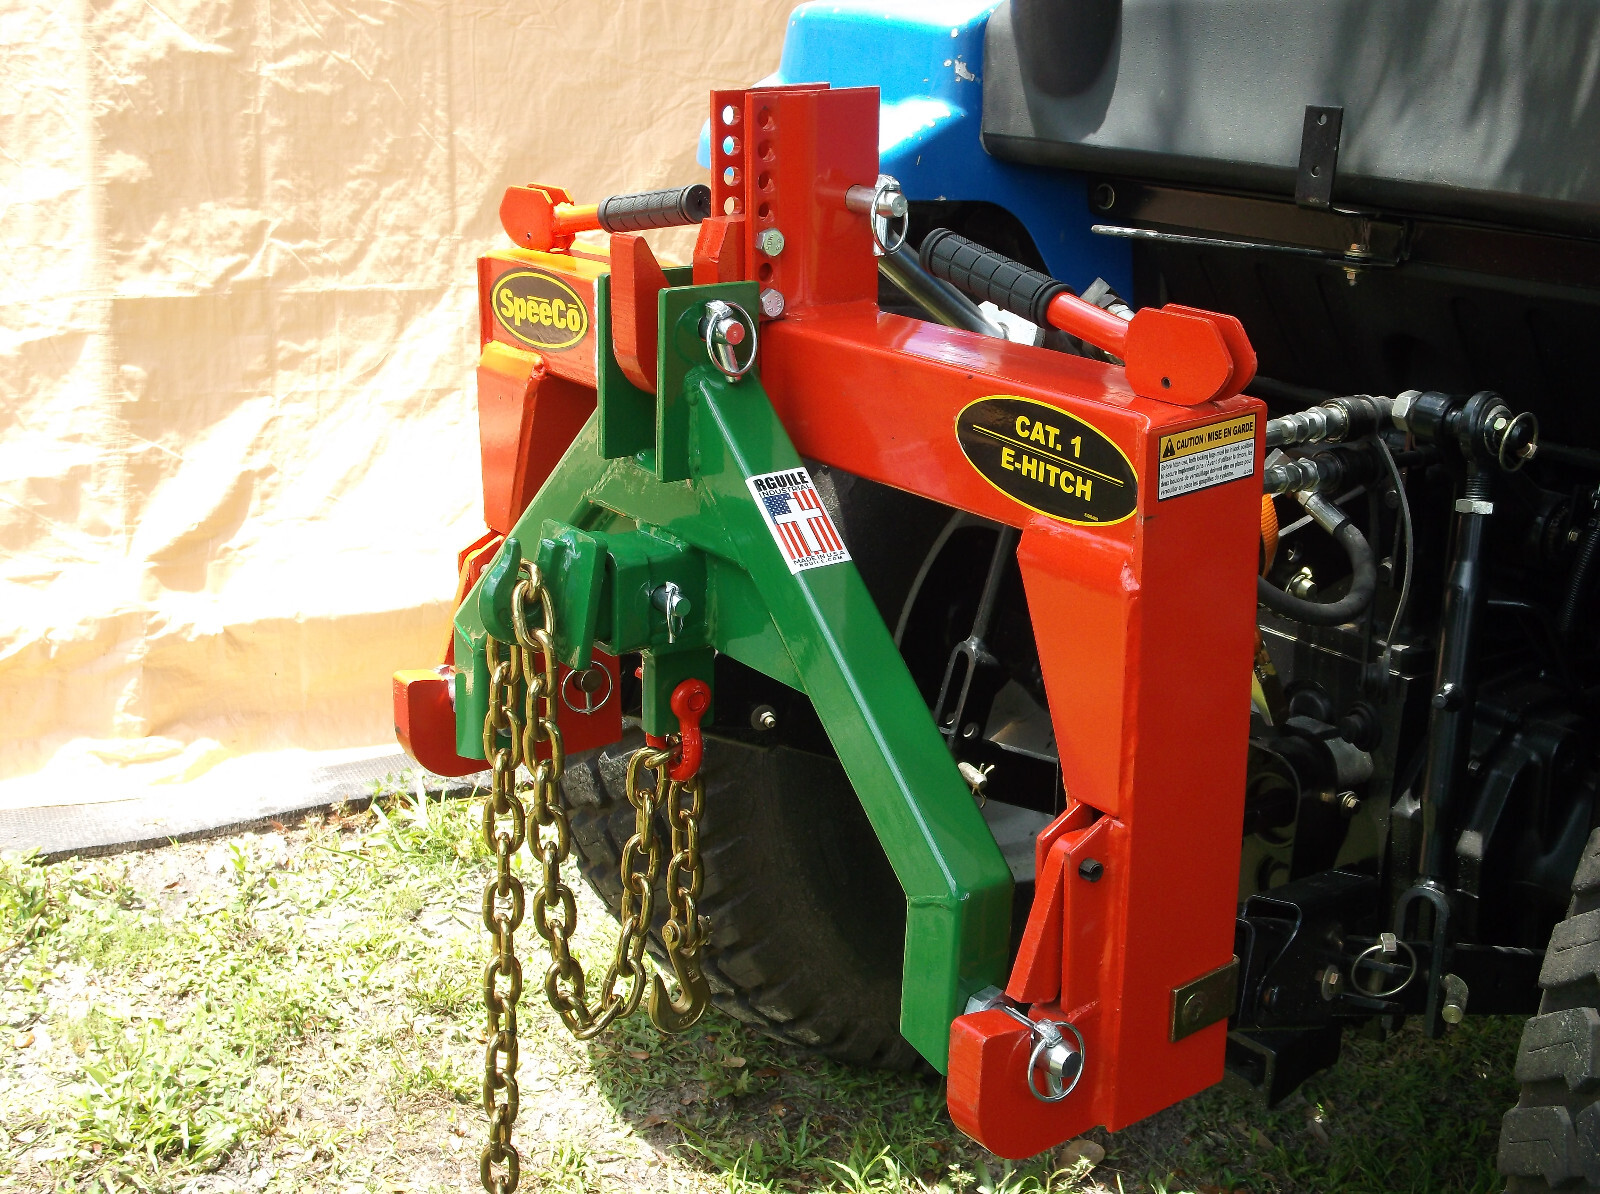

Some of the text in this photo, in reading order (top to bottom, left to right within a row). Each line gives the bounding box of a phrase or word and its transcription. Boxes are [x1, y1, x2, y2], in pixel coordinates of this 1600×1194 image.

[1015, 415, 1082, 458] CAT. 1
[1177, 435, 1204, 450] CAUTION
[1208, 429, 1222, 442] MISE
[1224, 427, 1232, 438] EN
[1233, 422, 1254, 435] GARDE
[753, 471, 809, 493] RGUILE
[1001, 446, 1093, 501] E-HITCH
[759, 484, 812, 499] INDUSTRIAL
[793, 556, 816, 566] MADE
